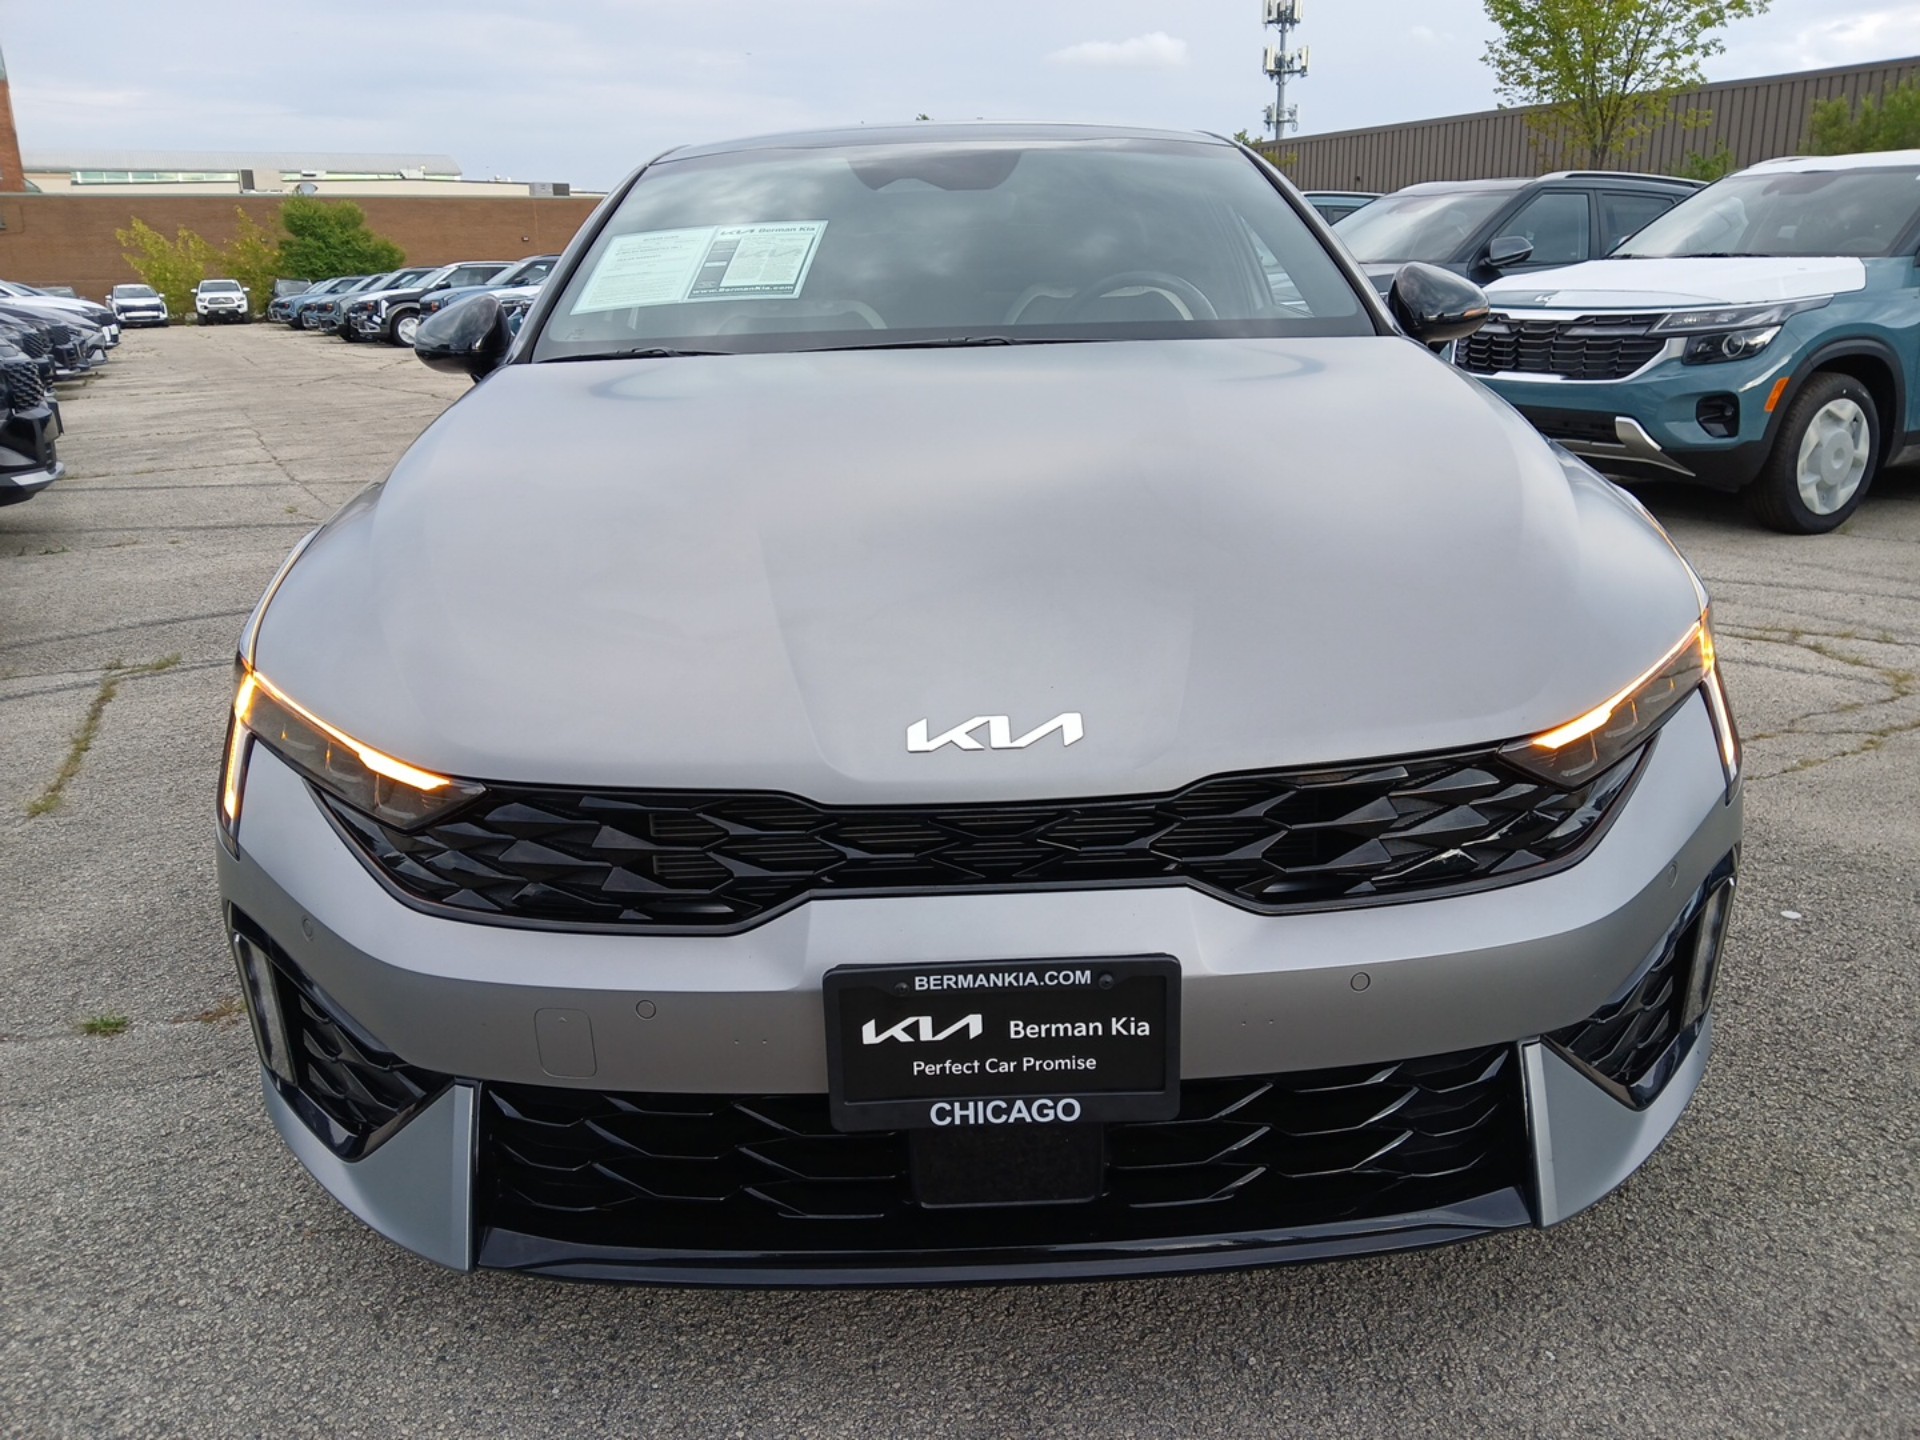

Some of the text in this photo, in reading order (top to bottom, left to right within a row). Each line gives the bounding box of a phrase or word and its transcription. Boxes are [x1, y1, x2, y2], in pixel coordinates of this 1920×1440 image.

[907, 712, 1084, 752] KIA
[915, 970, 1092, 991] BERMANKIA.COM
[862, 1013, 1151, 1045] KIA Berman Kia
[913, 1055, 1097, 1076] Perfect Car Promise
[930, 1098, 1081, 1126] CHICAGO
